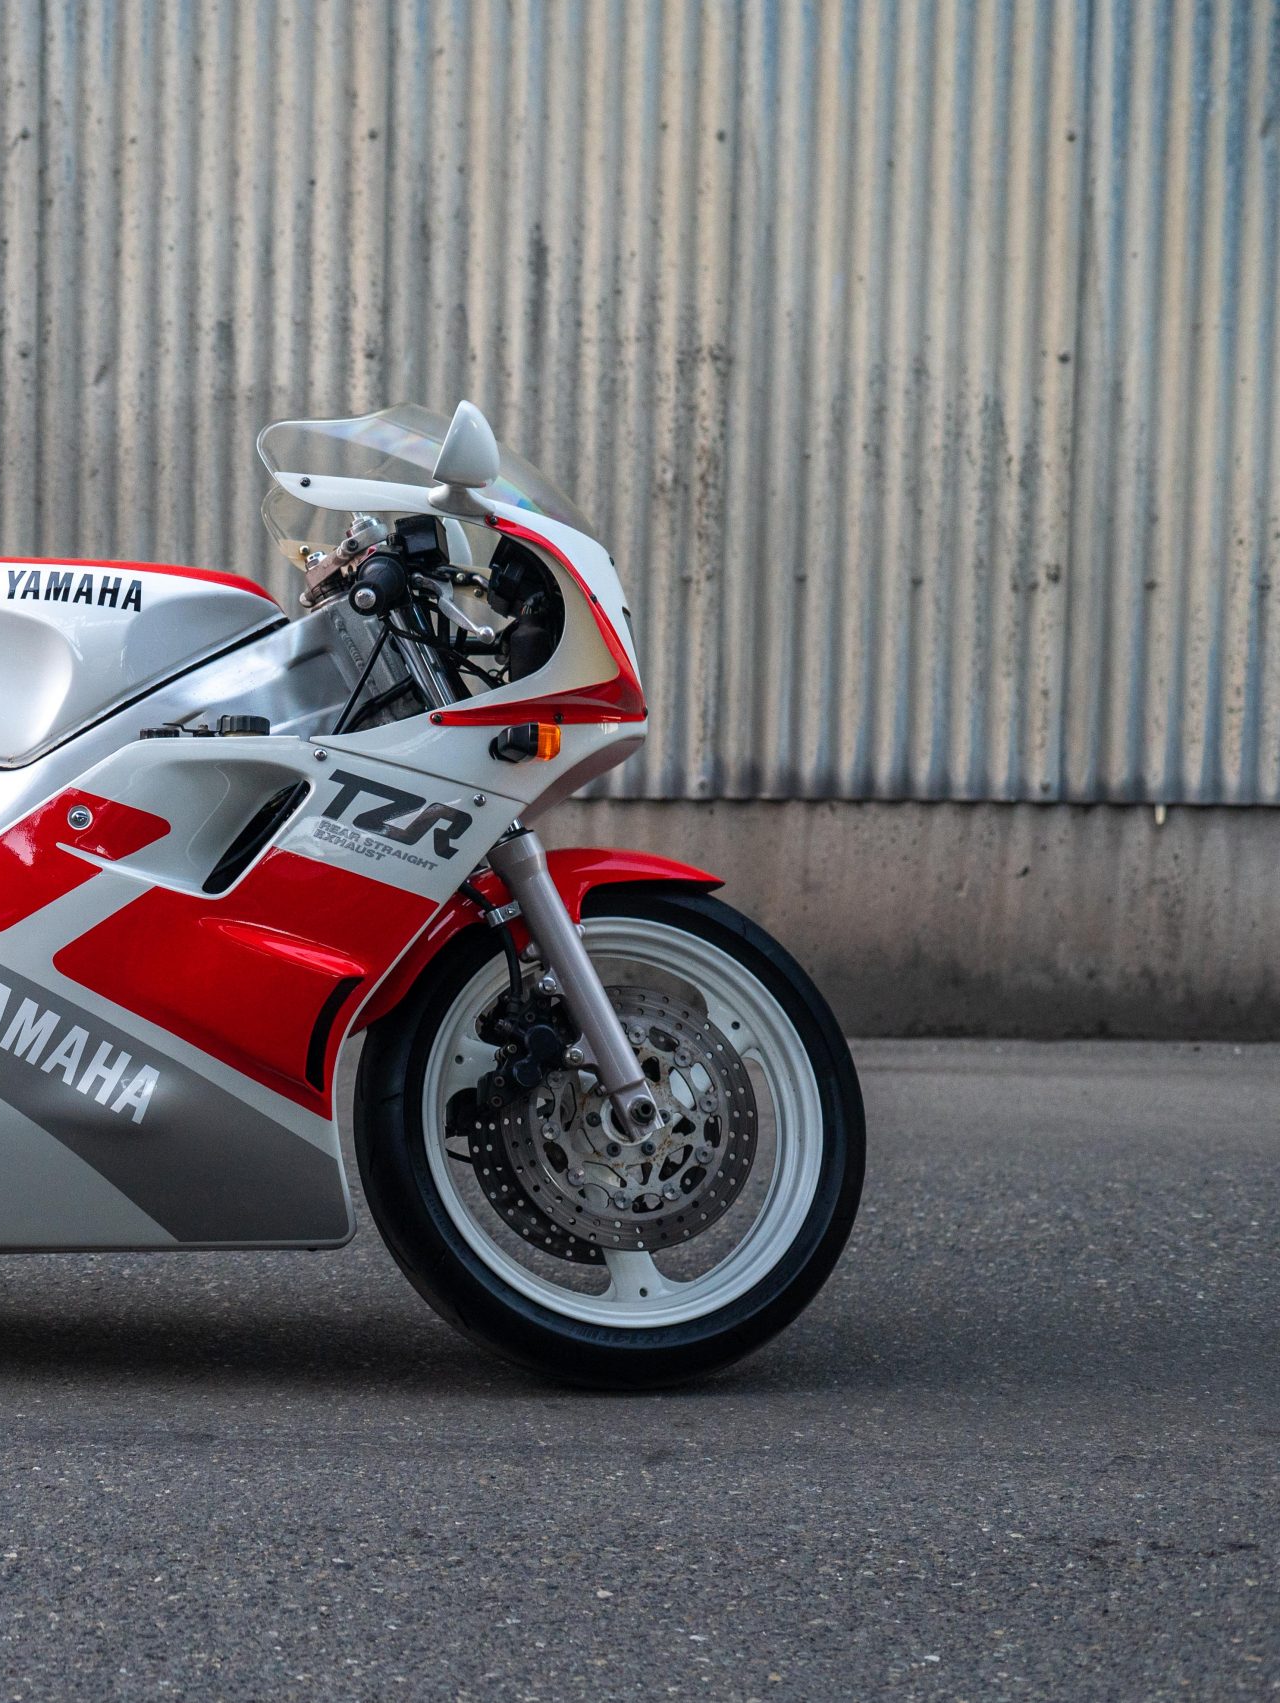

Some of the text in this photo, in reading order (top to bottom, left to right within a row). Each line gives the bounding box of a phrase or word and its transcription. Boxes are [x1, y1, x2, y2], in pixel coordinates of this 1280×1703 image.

[7, 570, 142, 612] YAMAHA
[321, 769, 473, 860] TZR
[313, 828, 386, 861] EXHAUST
[320, 819, 438, 871] REAR STRAIGHT
